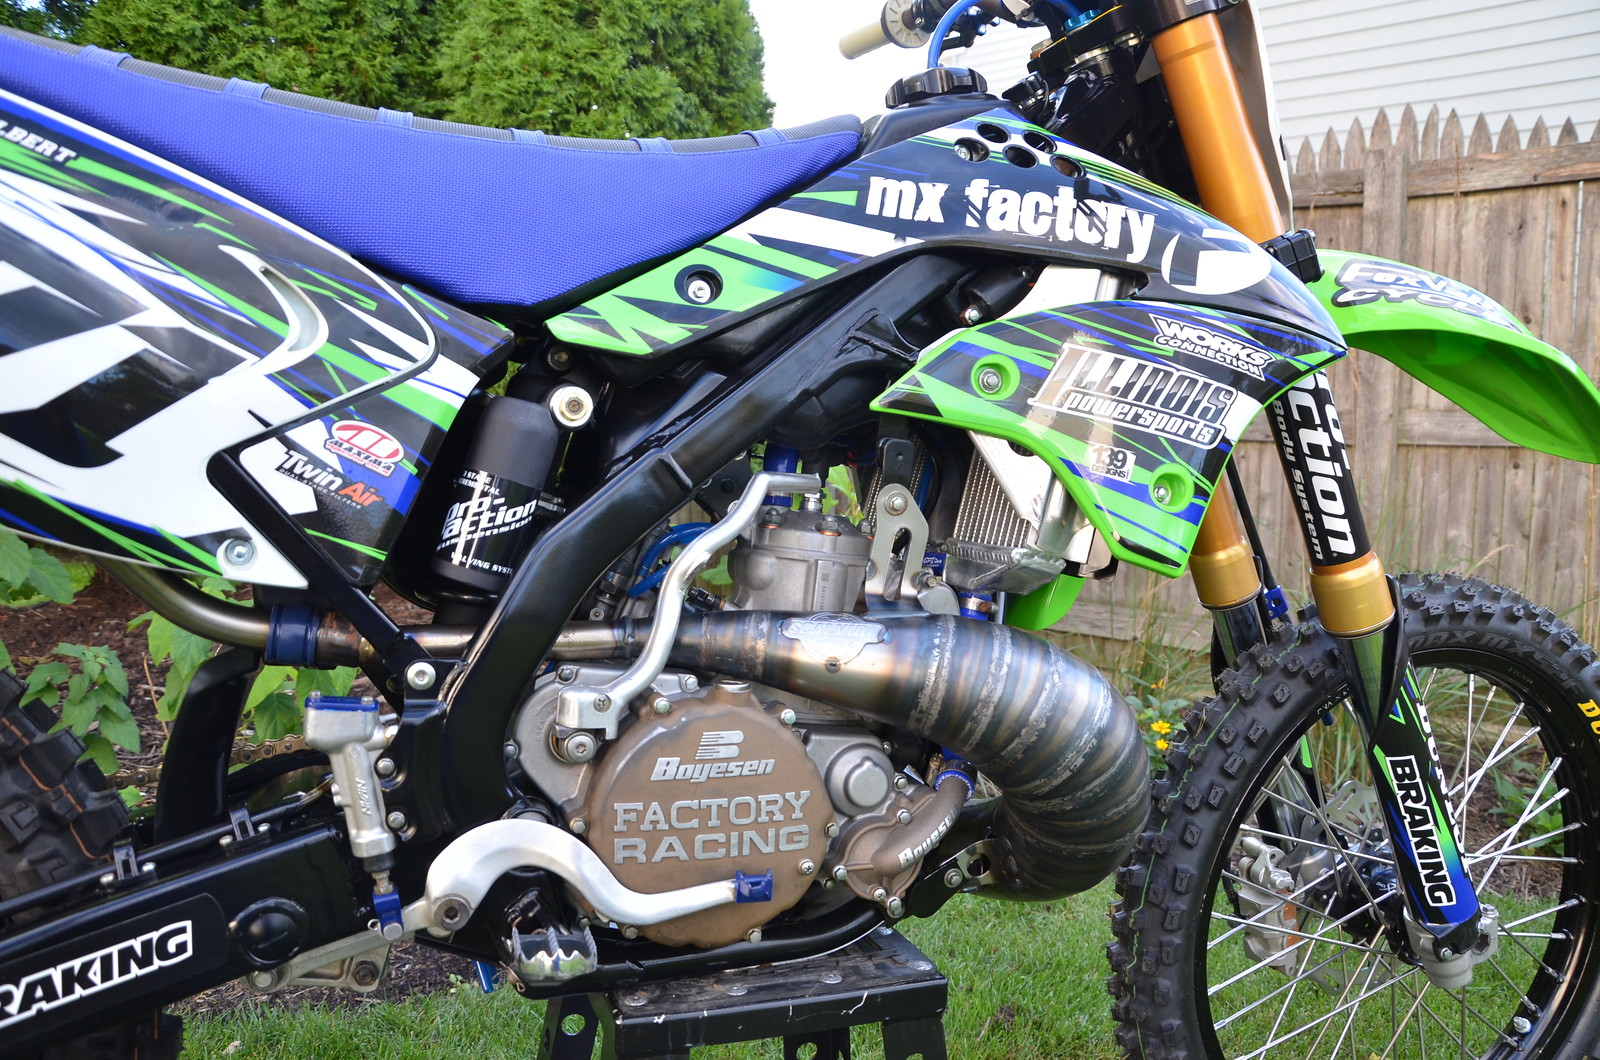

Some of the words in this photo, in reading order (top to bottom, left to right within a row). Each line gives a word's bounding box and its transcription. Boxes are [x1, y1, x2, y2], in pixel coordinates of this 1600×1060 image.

[865, 176, 949, 223] mx
[964, 178, 1158, 263] factory
[1155, 335, 1261, 377] CONNECTION
[1158, 318, 1272, 367] WORKS
[1065, 391, 1215, 444] powersports
[282, 450, 343, 491] Twin
[338, 482, 384, 507] Air
[467, 471, 492, 484] STAE
[1273, 400, 1296, 462] Body
[1292, 468, 1324, 560] System
[450, 551, 491, 569] VLVING
[650, 757, 775, 783] Boyesen
[613, 790, 810, 832] FACTORY
[1385, 754, 1457, 907] BRAKING
[613, 824, 810, 864] RACING
